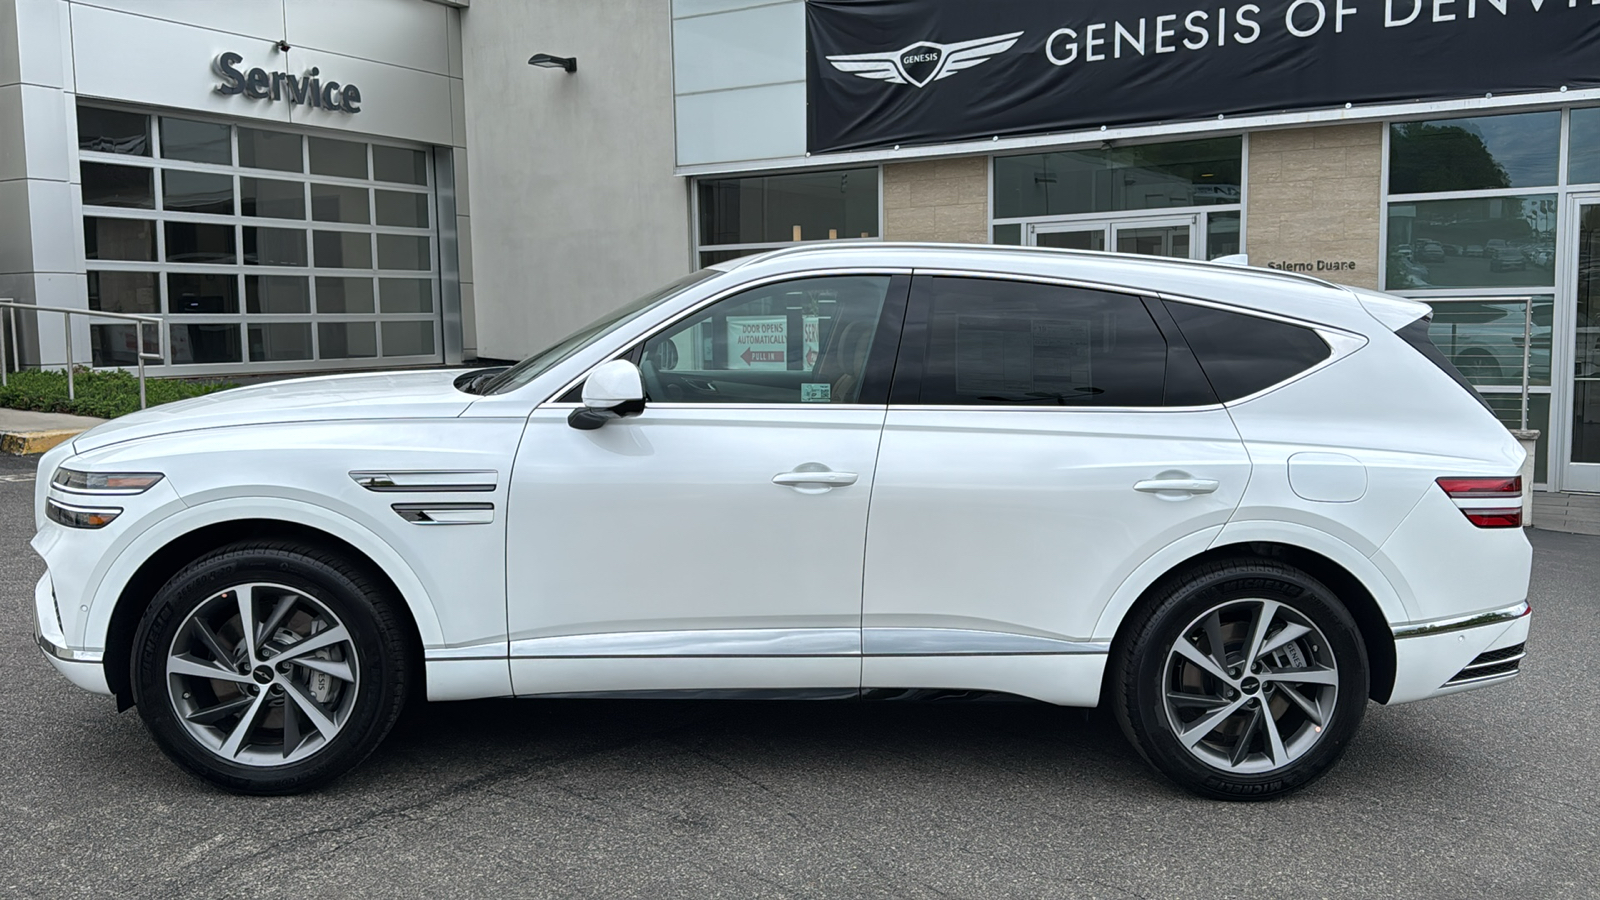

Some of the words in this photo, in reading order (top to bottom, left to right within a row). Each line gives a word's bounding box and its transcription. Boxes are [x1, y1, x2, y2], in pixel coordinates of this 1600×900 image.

[1045, 4, 1261, 66] GENESIS
[1285, 0, 1357, 37] OF
[1384, 0, 1600, 27] DEN
[903, 52, 938, 64] GENESIS
[217, 51, 361, 113] Service
[1267, 261, 1313, 271] Salerno
[742, 324, 760, 333] DOOR
[761, 323, 784, 333] OPENS
[805, 323, 819, 342] SER
[751, 352, 767, 360] PULL
[768, 352, 775, 360] IN
[1286, 643, 1303, 667] GENES
